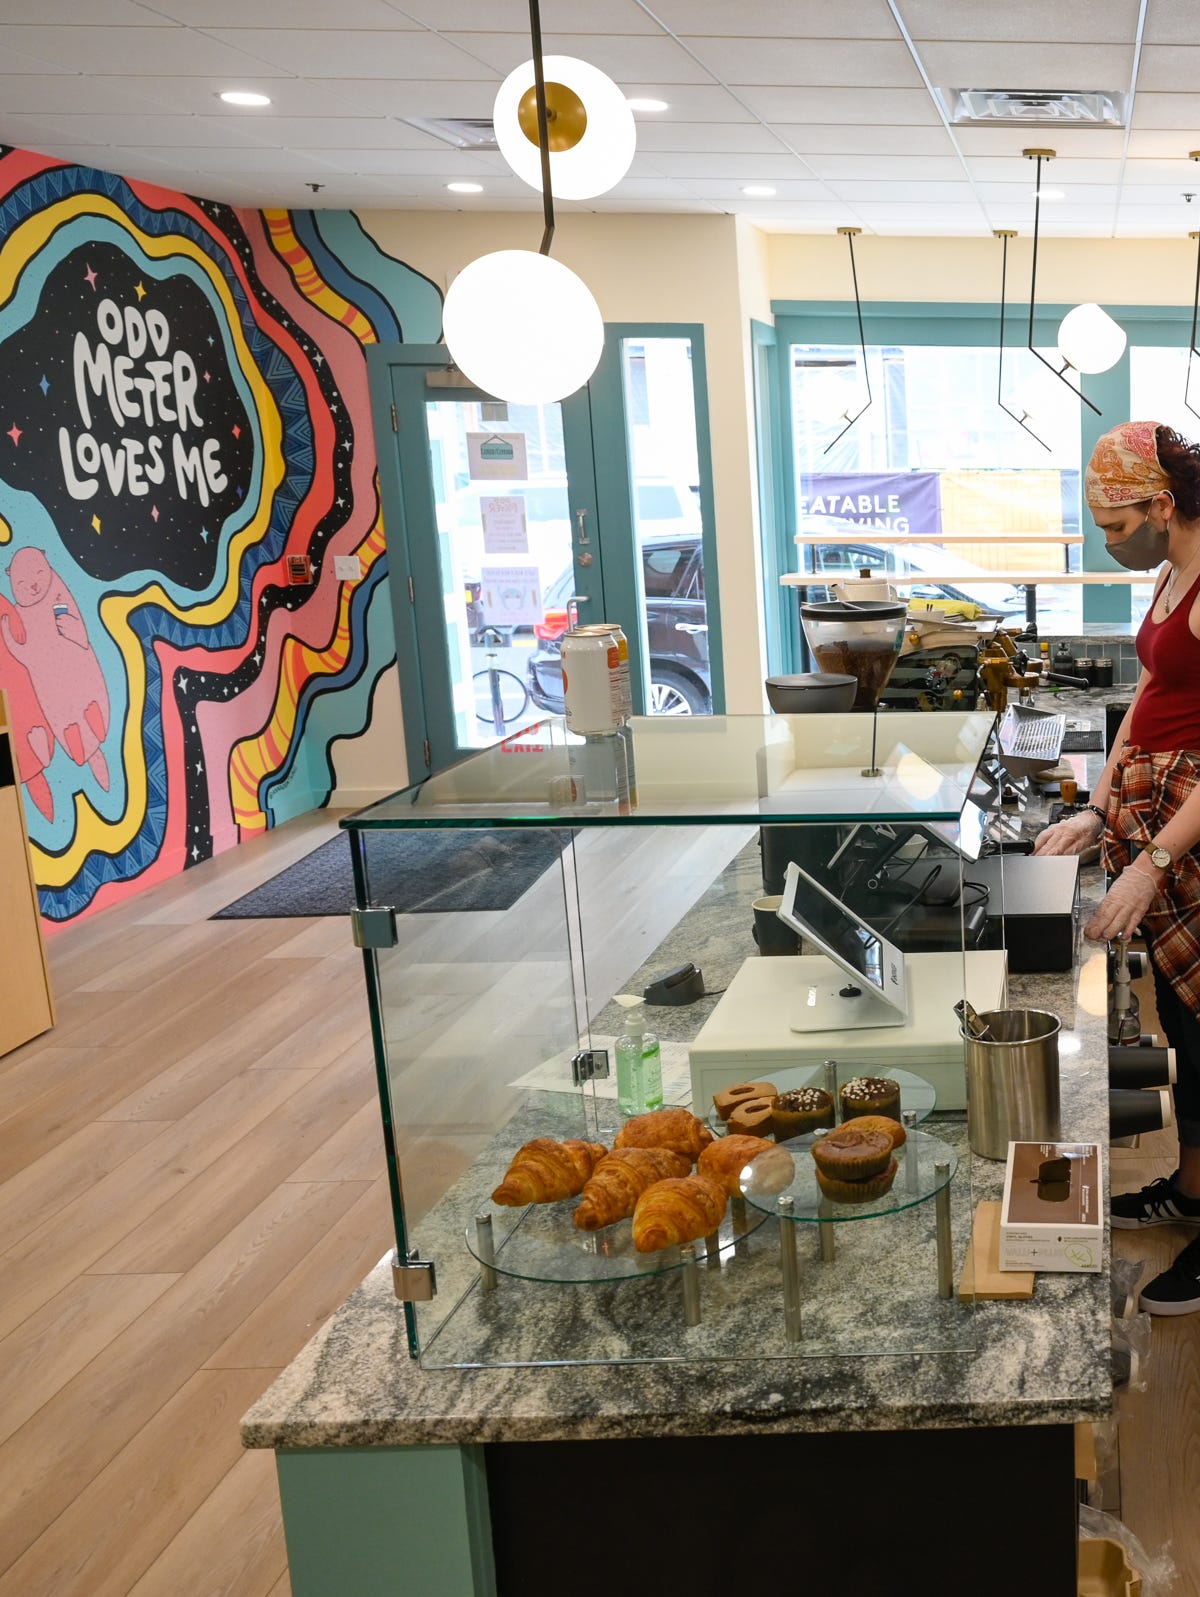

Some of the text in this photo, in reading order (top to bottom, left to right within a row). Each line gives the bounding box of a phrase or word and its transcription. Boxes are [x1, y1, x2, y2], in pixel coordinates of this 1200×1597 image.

[97, 298, 170, 359] ODD
[73, 331, 204, 432] METER
[59, 426, 228, 508] LOVES ME
